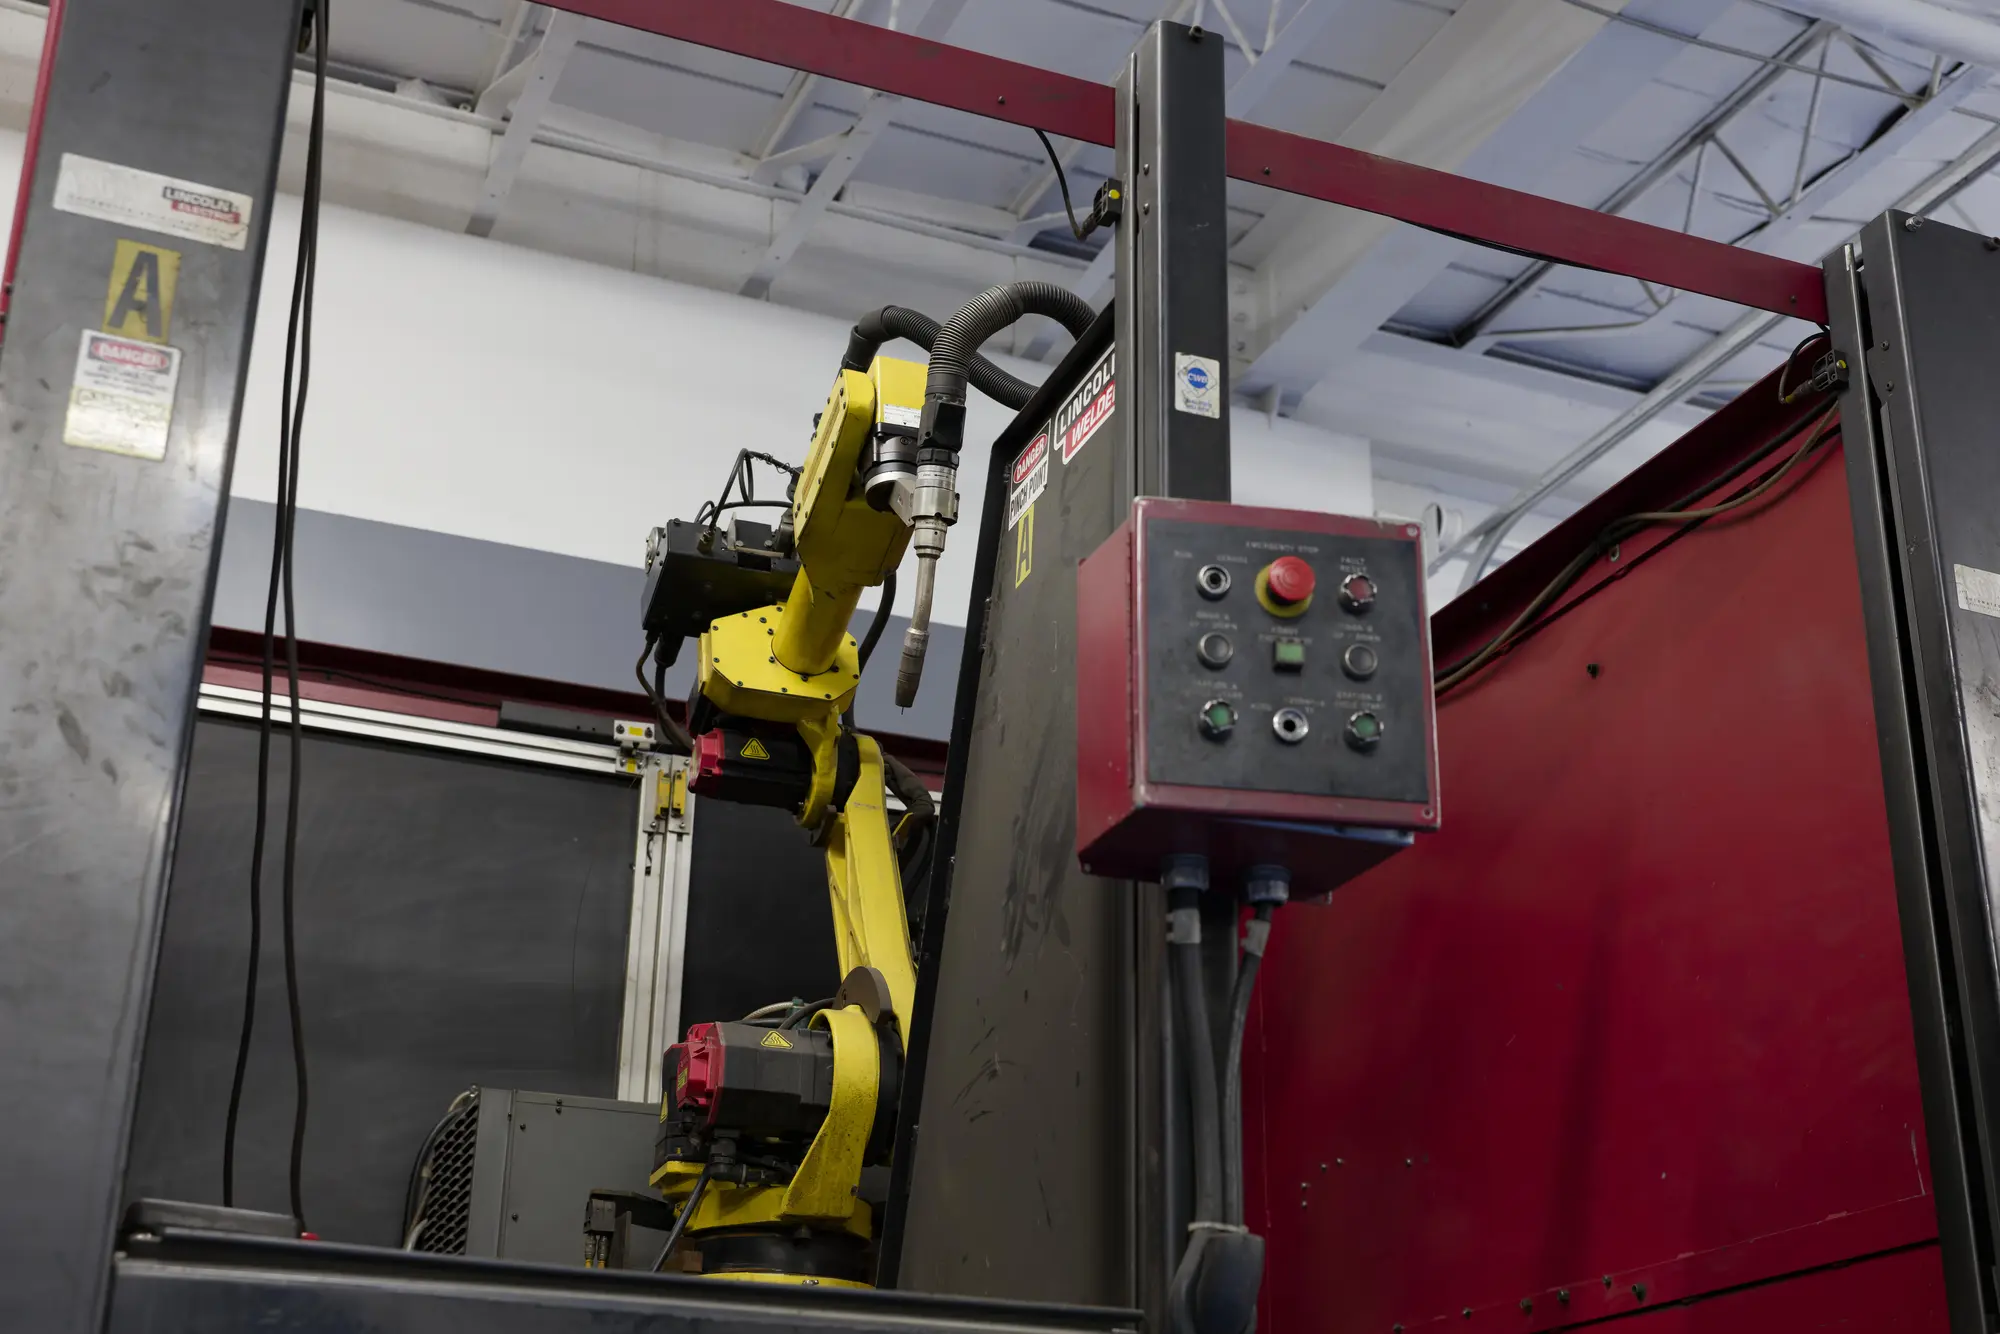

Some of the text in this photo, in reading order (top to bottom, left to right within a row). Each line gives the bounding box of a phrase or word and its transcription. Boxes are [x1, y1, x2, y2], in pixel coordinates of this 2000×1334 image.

[165, 187, 230, 212] LINCOLN
[107, 250, 164, 338] A
[98, 342, 163, 369] DANGER
[1016, 437, 1045, 479] DANGER
[1010, 459, 1047, 521] PINCH POINT
[1016, 513, 1031, 583] A
